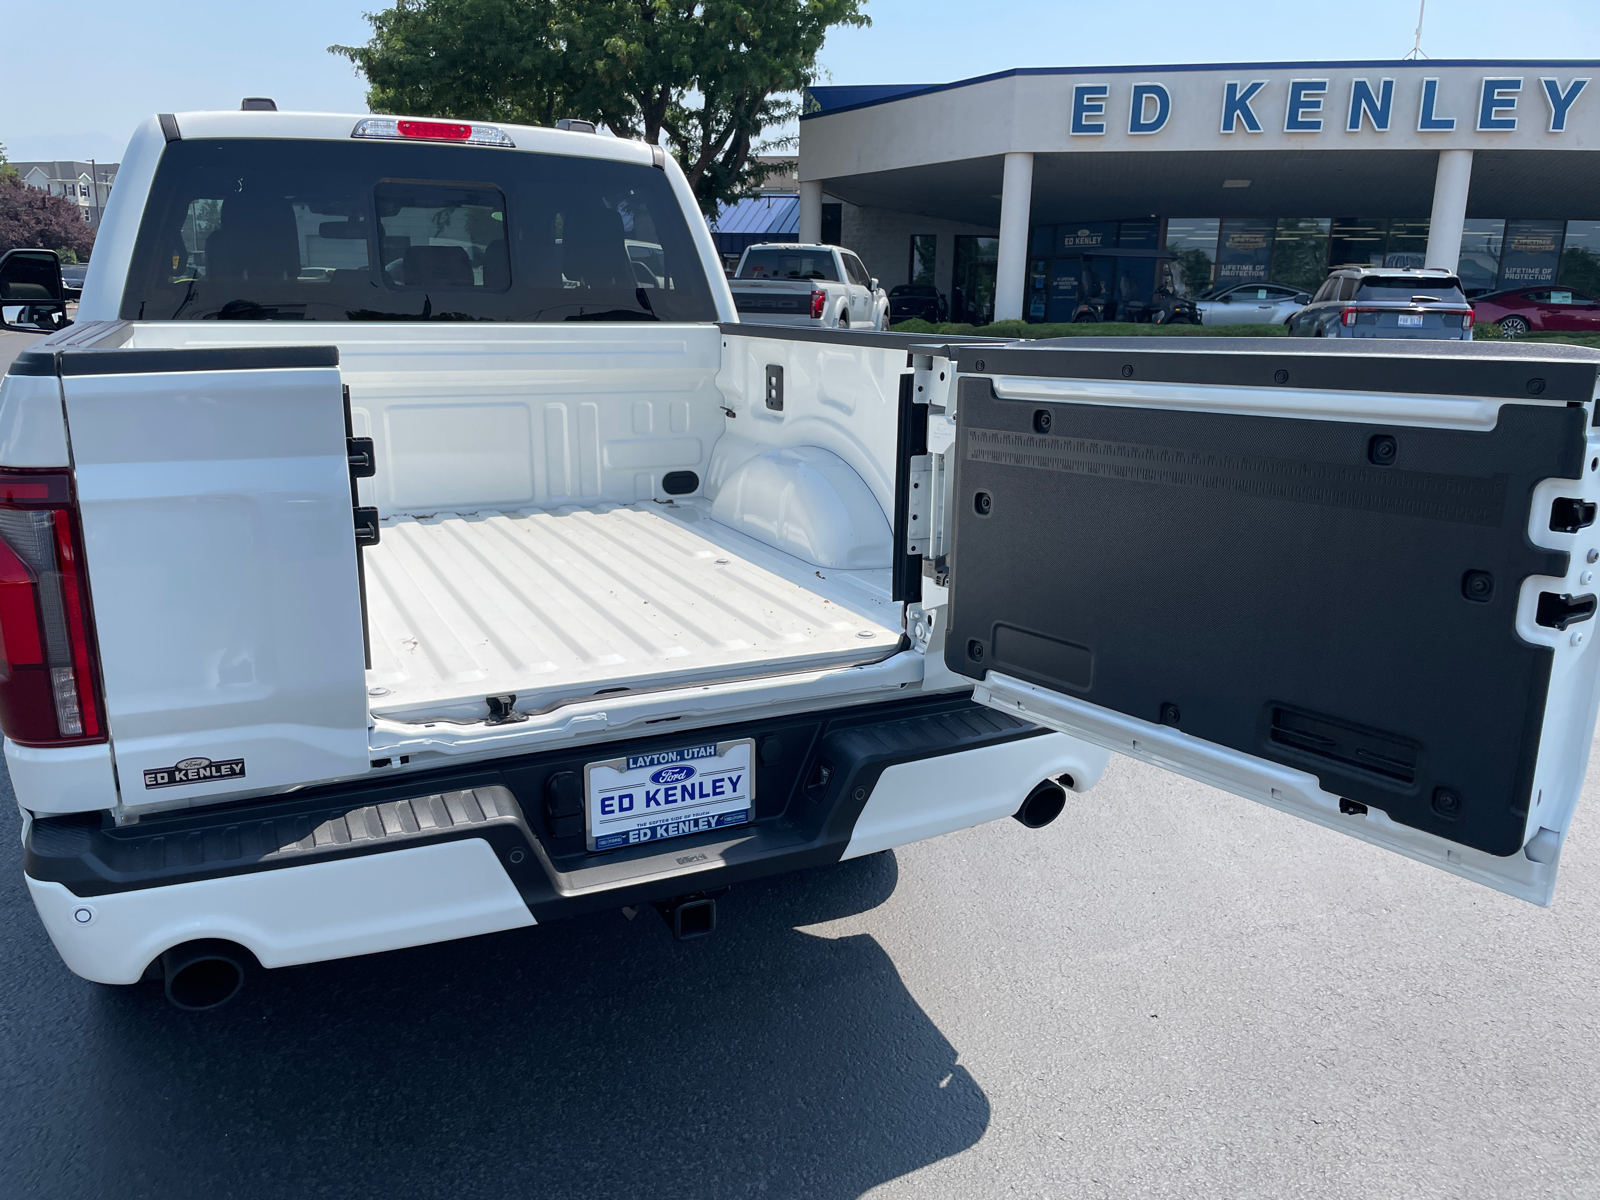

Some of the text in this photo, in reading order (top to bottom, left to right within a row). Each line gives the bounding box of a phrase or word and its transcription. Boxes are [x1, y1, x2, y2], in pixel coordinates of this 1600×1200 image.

[1070, 76, 1592, 136] ED KENLEY
[1064, 236, 1102, 245] ED KENLEY
[184, 760, 203, 768] Ford
[629, 746, 715, 769] LAYTON, UTAH
[145, 763, 243, 785] ED KENLEY
[659, 768, 687, 783] Ford
[600, 775, 742, 816] ED KENLEY
[629, 815, 719, 844] ED KENLEY
